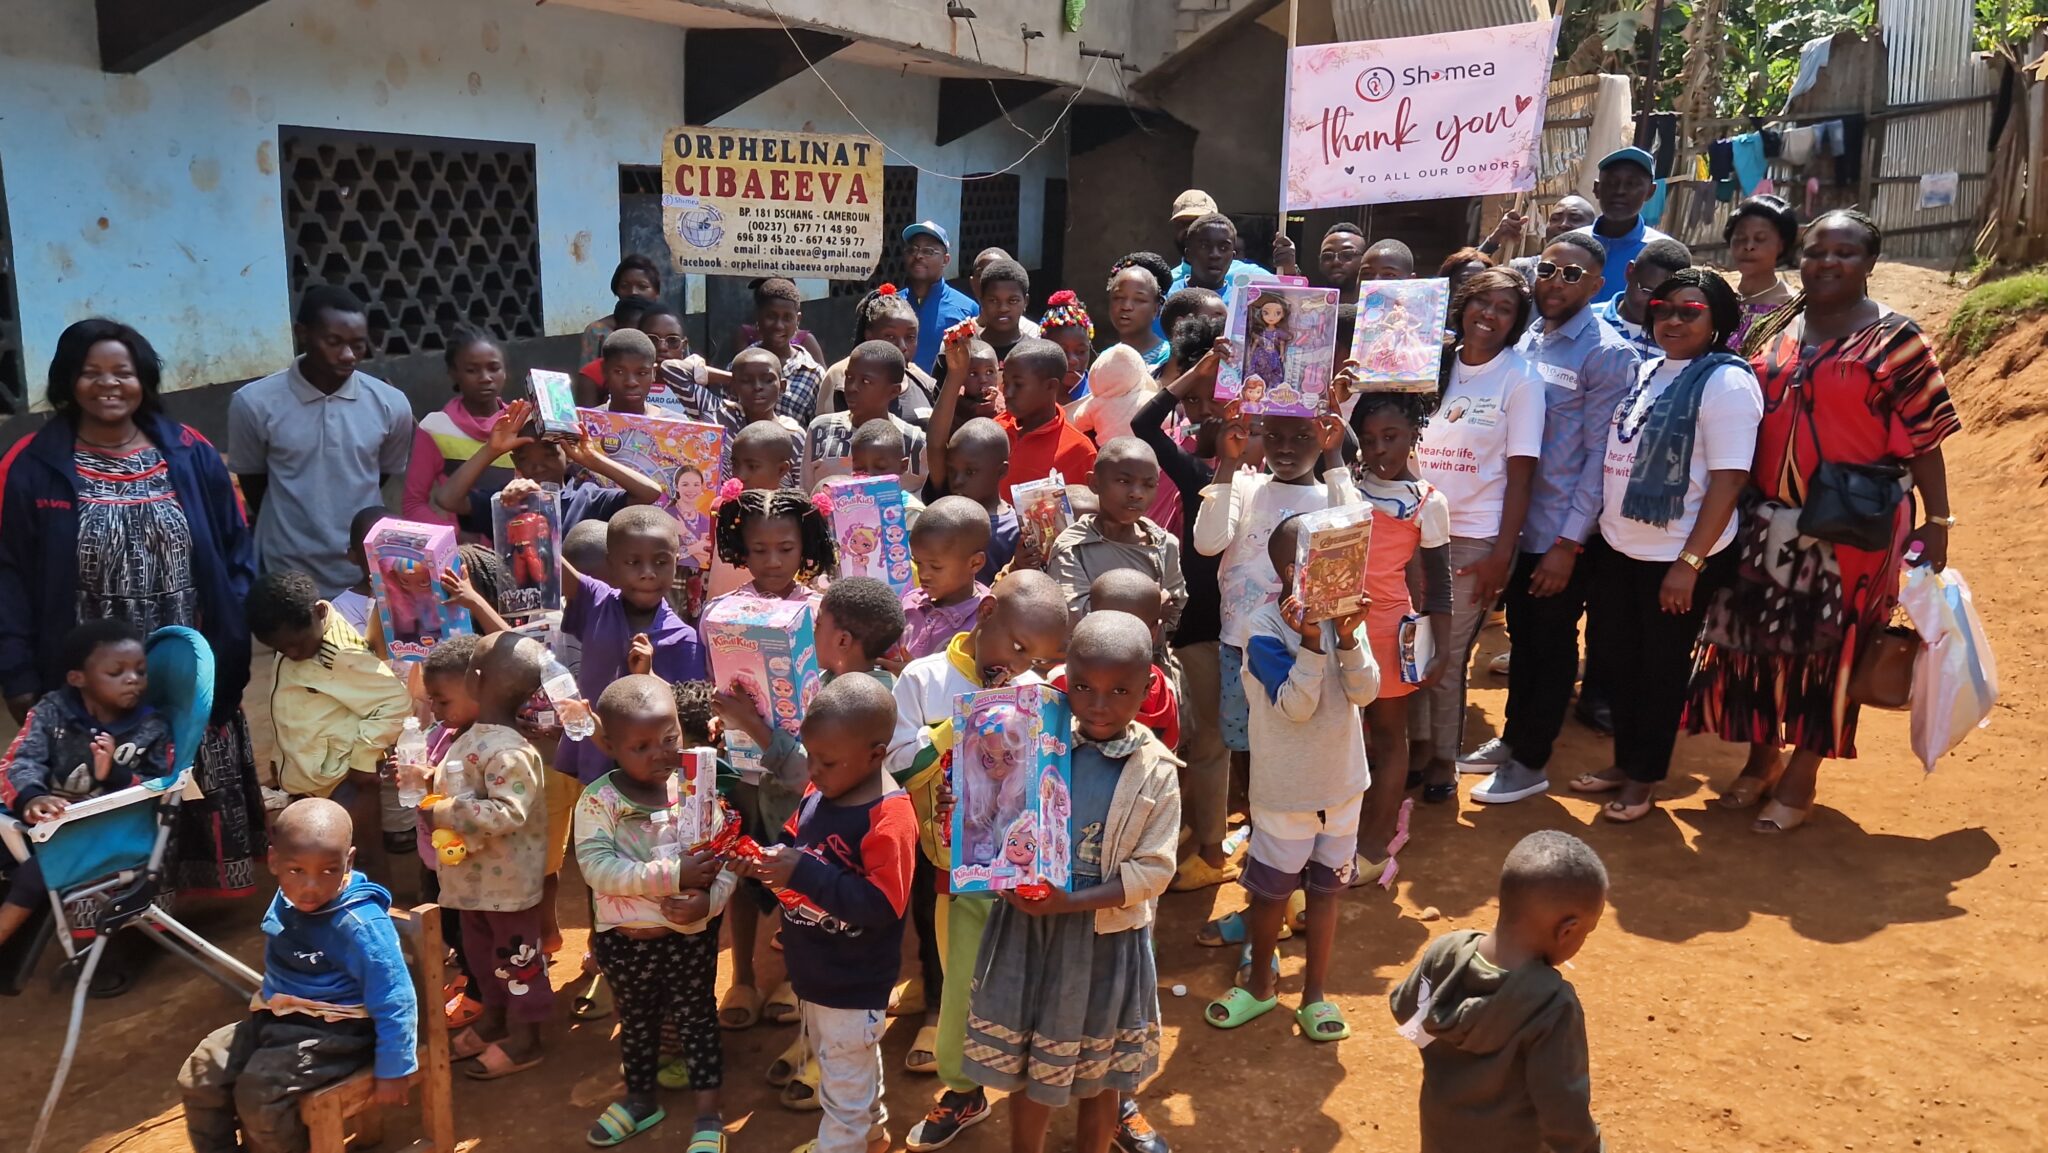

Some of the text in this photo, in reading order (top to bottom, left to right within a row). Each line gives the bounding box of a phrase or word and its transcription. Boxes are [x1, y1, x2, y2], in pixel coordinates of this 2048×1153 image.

[1305, 96, 1524, 165] thank you
[673, 133, 871, 166] ORPHELINAT
[1359, 160, 1520, 184] TO ALL OUR DONORS
[674, 163, 869, 205] CIBAEEVA
[739, 207, 751, 217] BP.
[755, 208, 771, 218] 181
[774, 208, 813, 220] DSCHANG
[823, 210, 870, 222] CAMEROUN
[748, 220, 857, 235] (00237) 677 71 48 90
[737, 232, 754, 242] 696
[756, 233, 768, 243] 89
[770, 234, 782, 243] 45
[785, 234, 797, 244] 20
[805, 235, 823, 245] 667
[825, 236, 837, 246] 42
[840, 236, 852, 246] 59
[854, 237, 865, 247] 77
[733, 244, 760, 255] email
[769, 245, 871, 260] cibaeeva@gmail.com
[679, 256, 722, 269] facebook
[731, 259, 779, 273] orphelinat
[781, 261, 822, 272] cibaeeva
[823, 262, 872, 276] orphanage
[604, 436, 619, 445] NEW
[1456, 447, 1477, 461] life,
[1430, 459, 1453, 471] with
[1615, 467, 1630, 478] wit
